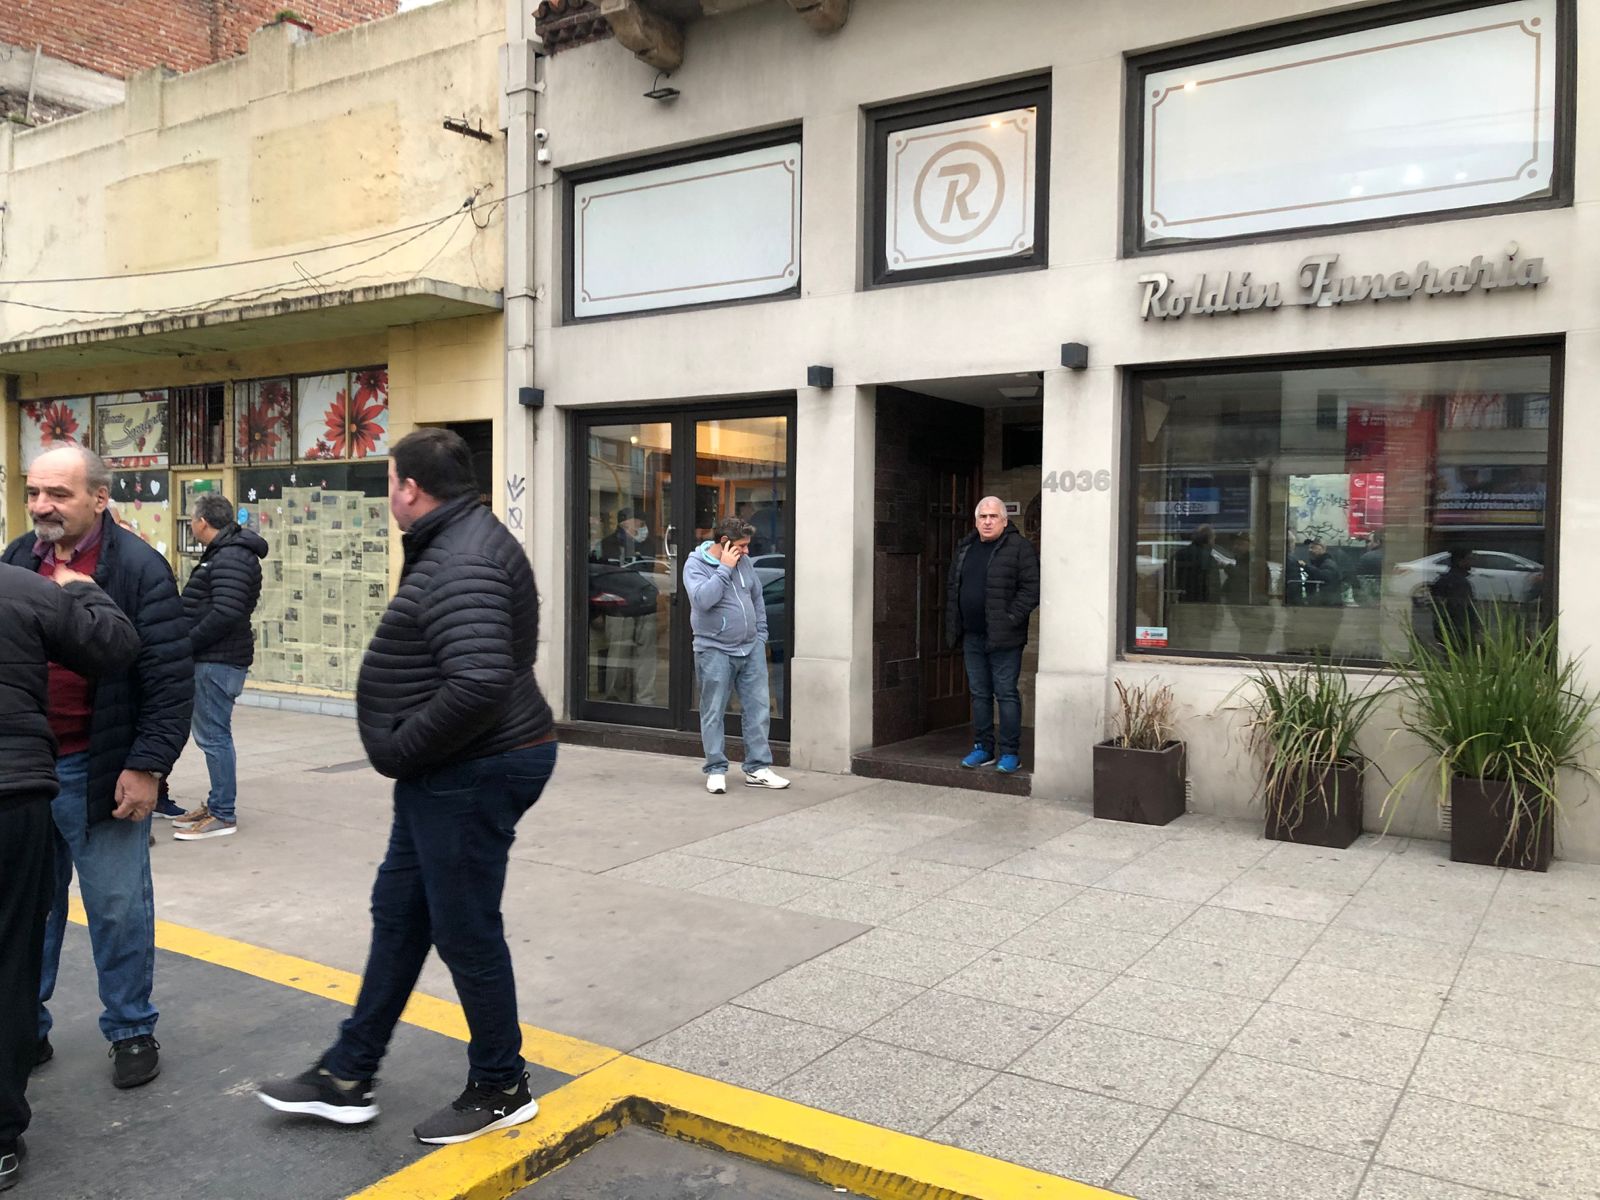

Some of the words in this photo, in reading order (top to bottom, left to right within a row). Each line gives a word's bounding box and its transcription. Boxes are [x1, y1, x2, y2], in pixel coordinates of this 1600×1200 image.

[937, 162, 981, 224] R
[1138, 271, 1283, 320] Roldán
[1298, 241, 1549, 307] Funeraria
[1042, 469, 1111, 493] 4036
